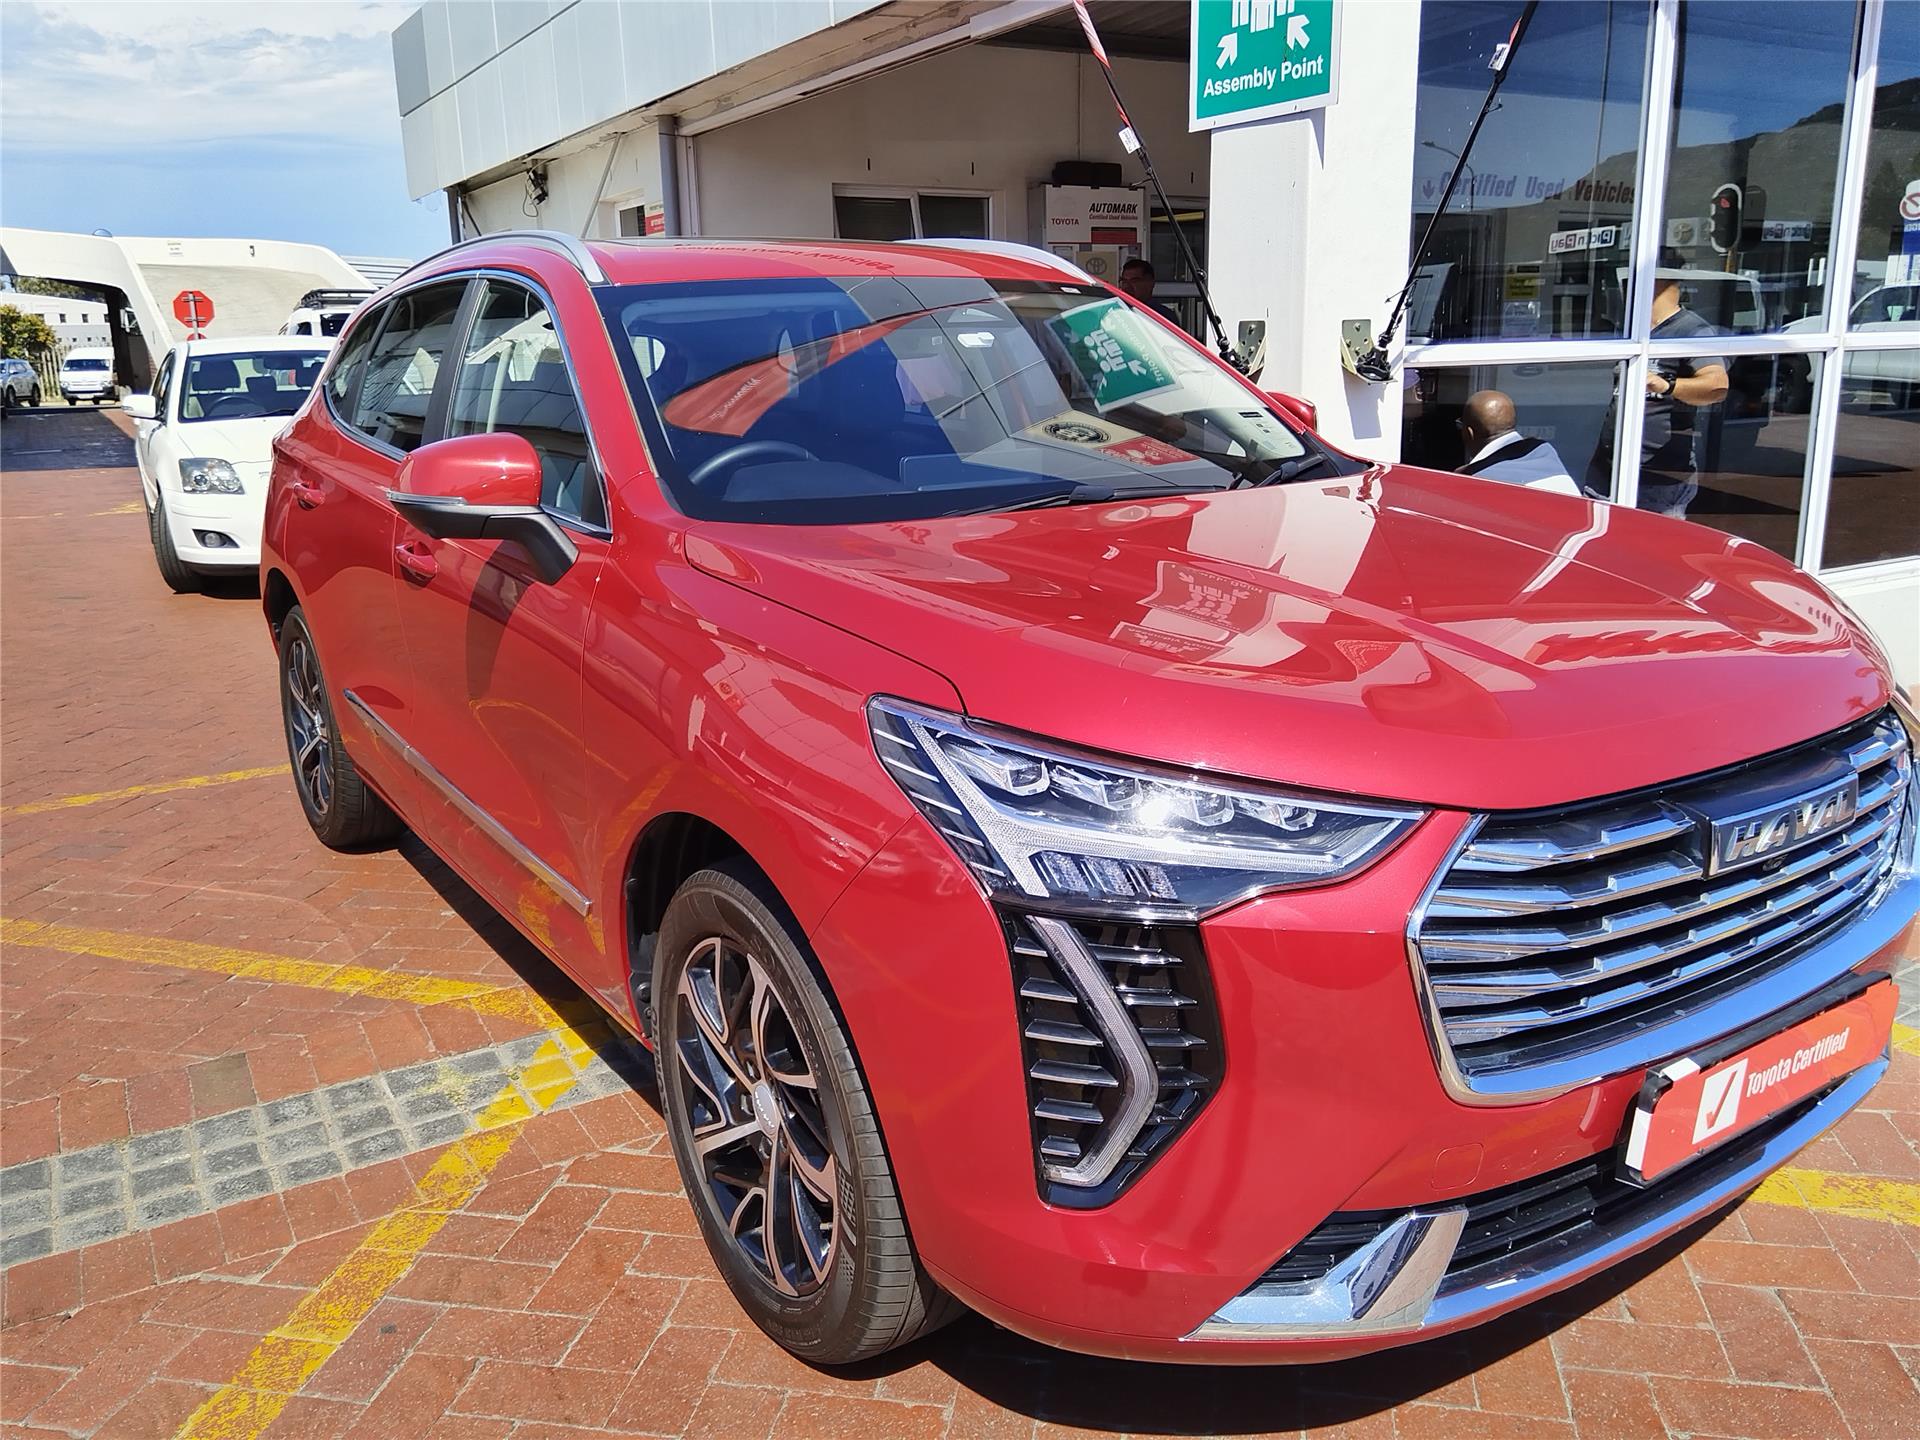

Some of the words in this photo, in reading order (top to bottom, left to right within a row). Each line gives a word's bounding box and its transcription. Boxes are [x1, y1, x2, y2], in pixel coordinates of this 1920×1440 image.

[1203, 66, 1277, 98] Assembly
[1281, 54, 1324, 82] Point
[1524, 176, 1565, 200] Used
[1051, 217, 1080, 226] TOYOTA
[1088, 202, 1138, 214] AUTOMARK
[1724, 788, 1856, 862] HAVAL
[1746, 1058, 1793, 1098] Toyota
[1791, 1026, 1850, 1074] Certified
